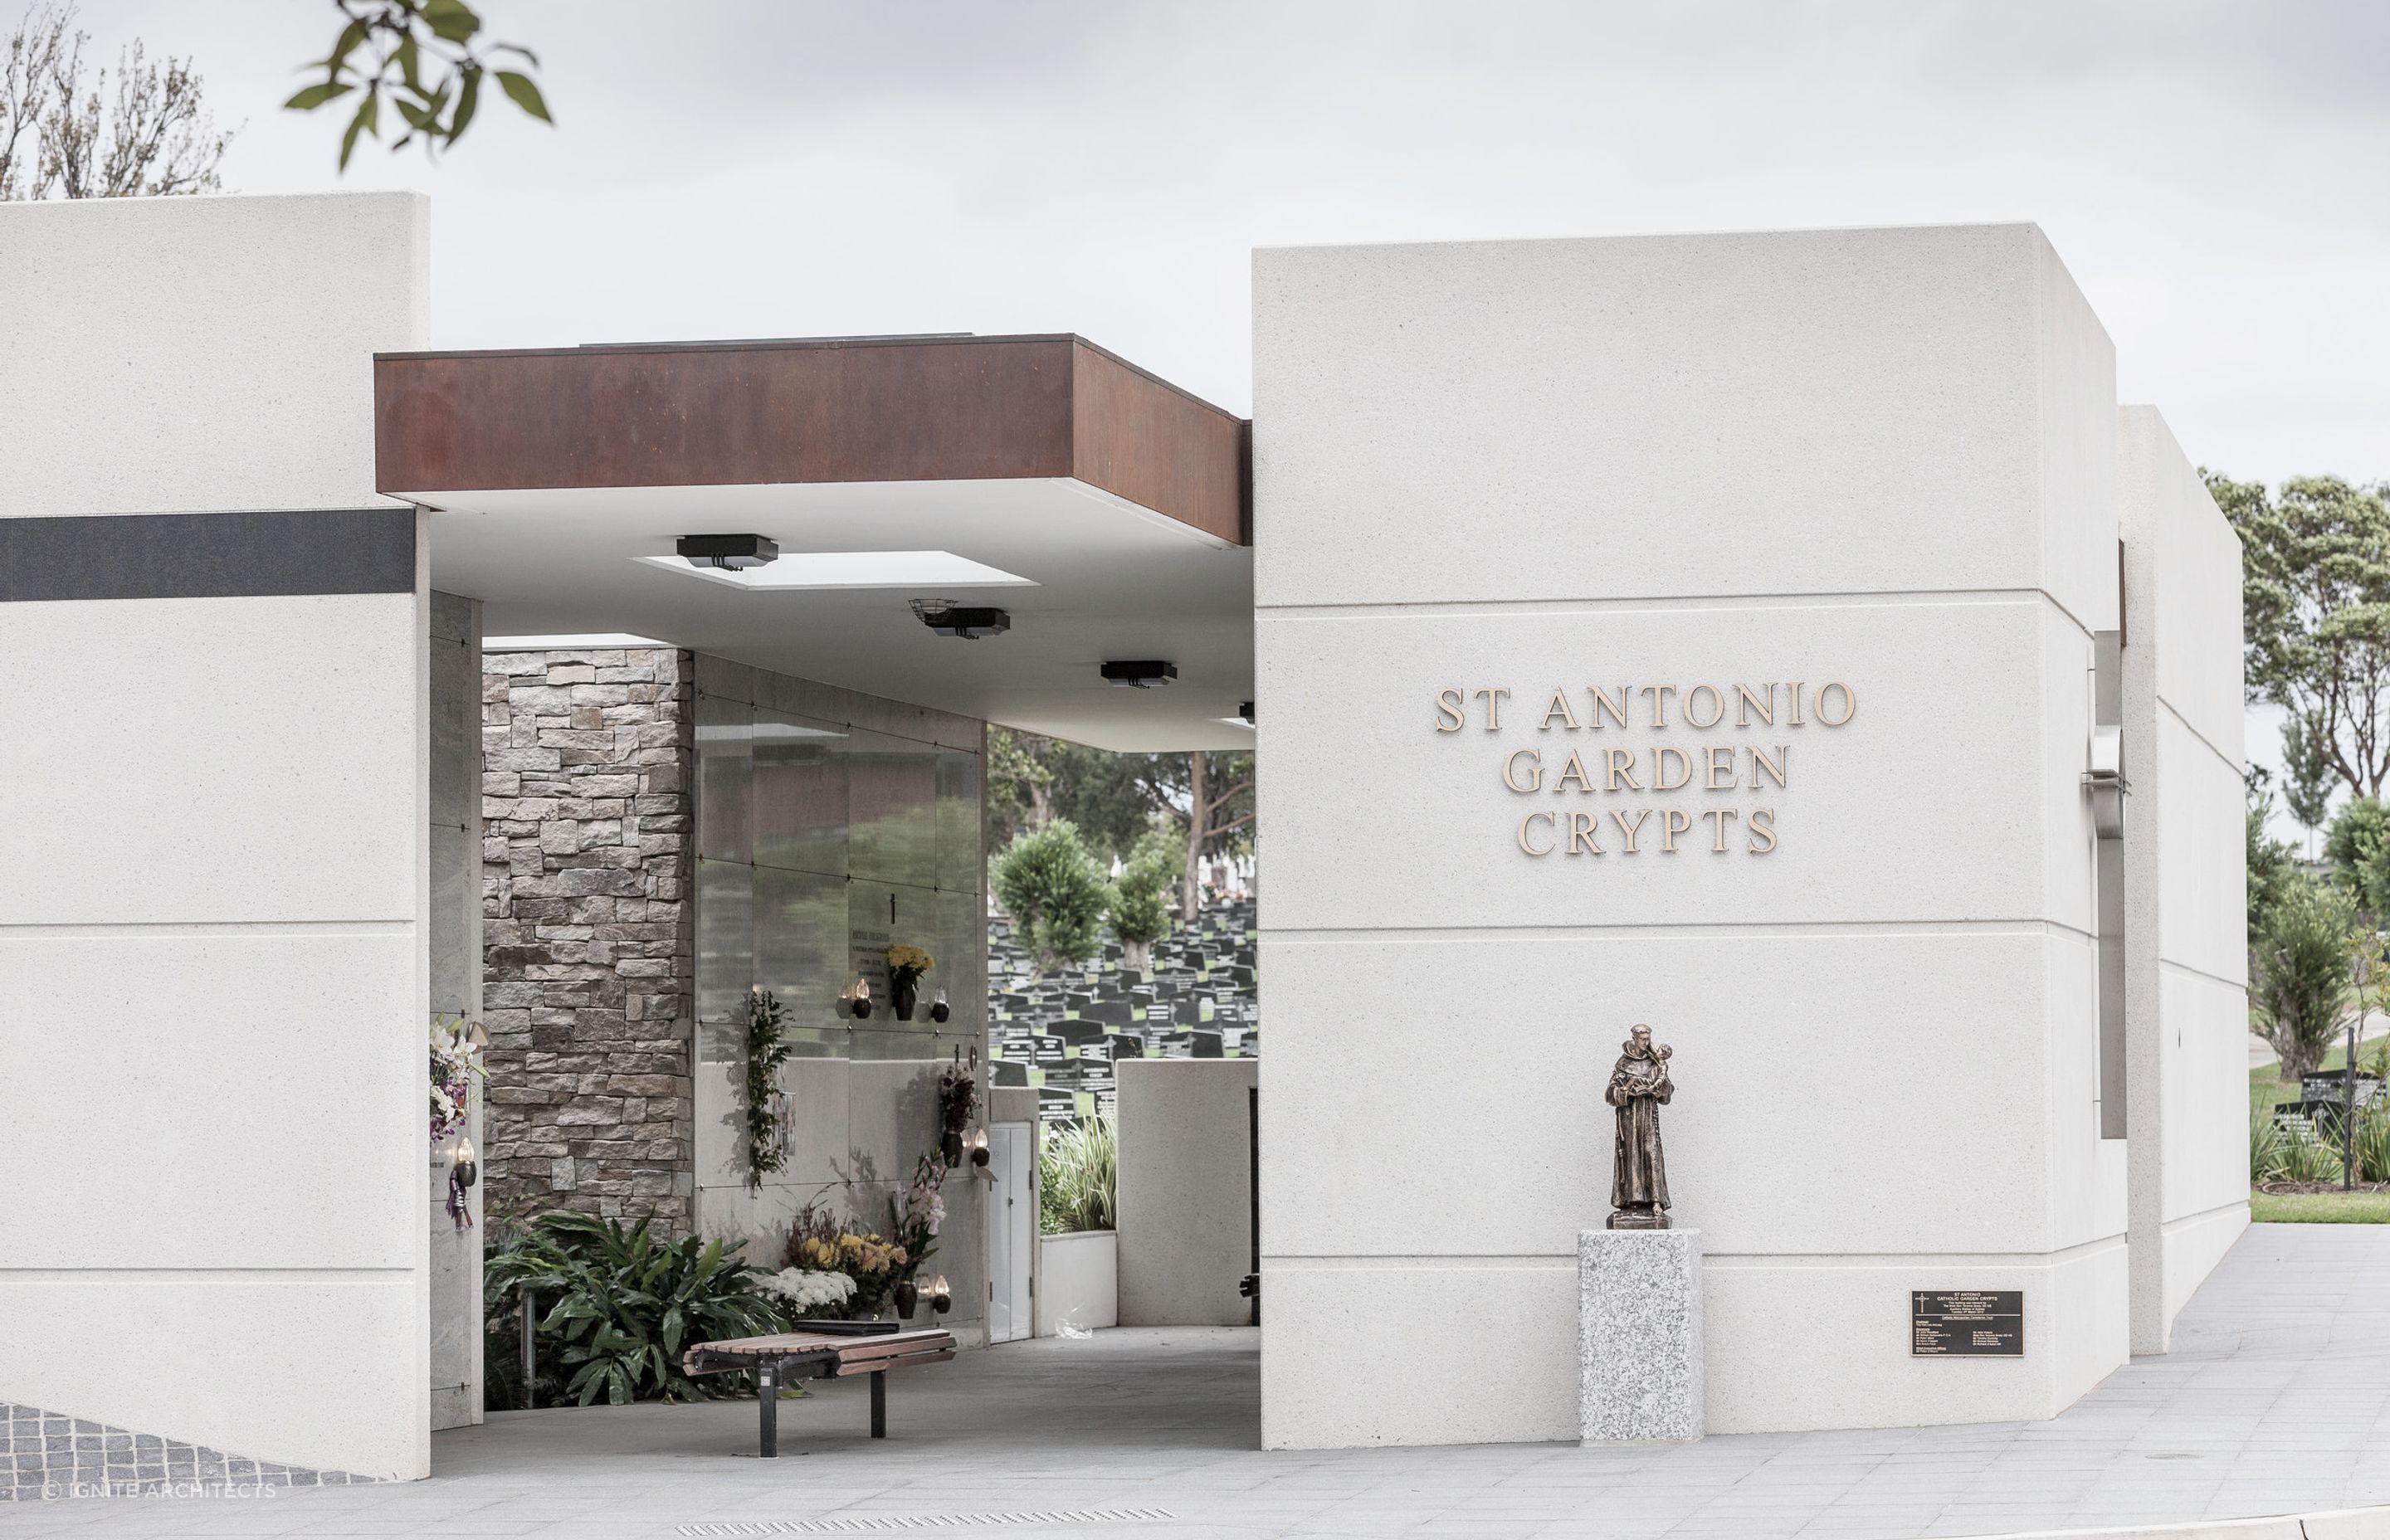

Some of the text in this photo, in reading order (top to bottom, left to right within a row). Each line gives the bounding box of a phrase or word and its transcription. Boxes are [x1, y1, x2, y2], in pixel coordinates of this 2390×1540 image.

[1436, 680, 1857, 733] ST ANTONIO
[1502, 743, 1791, 793] GARDEN
[1517, 808, 1778, 856] CRYPTS
